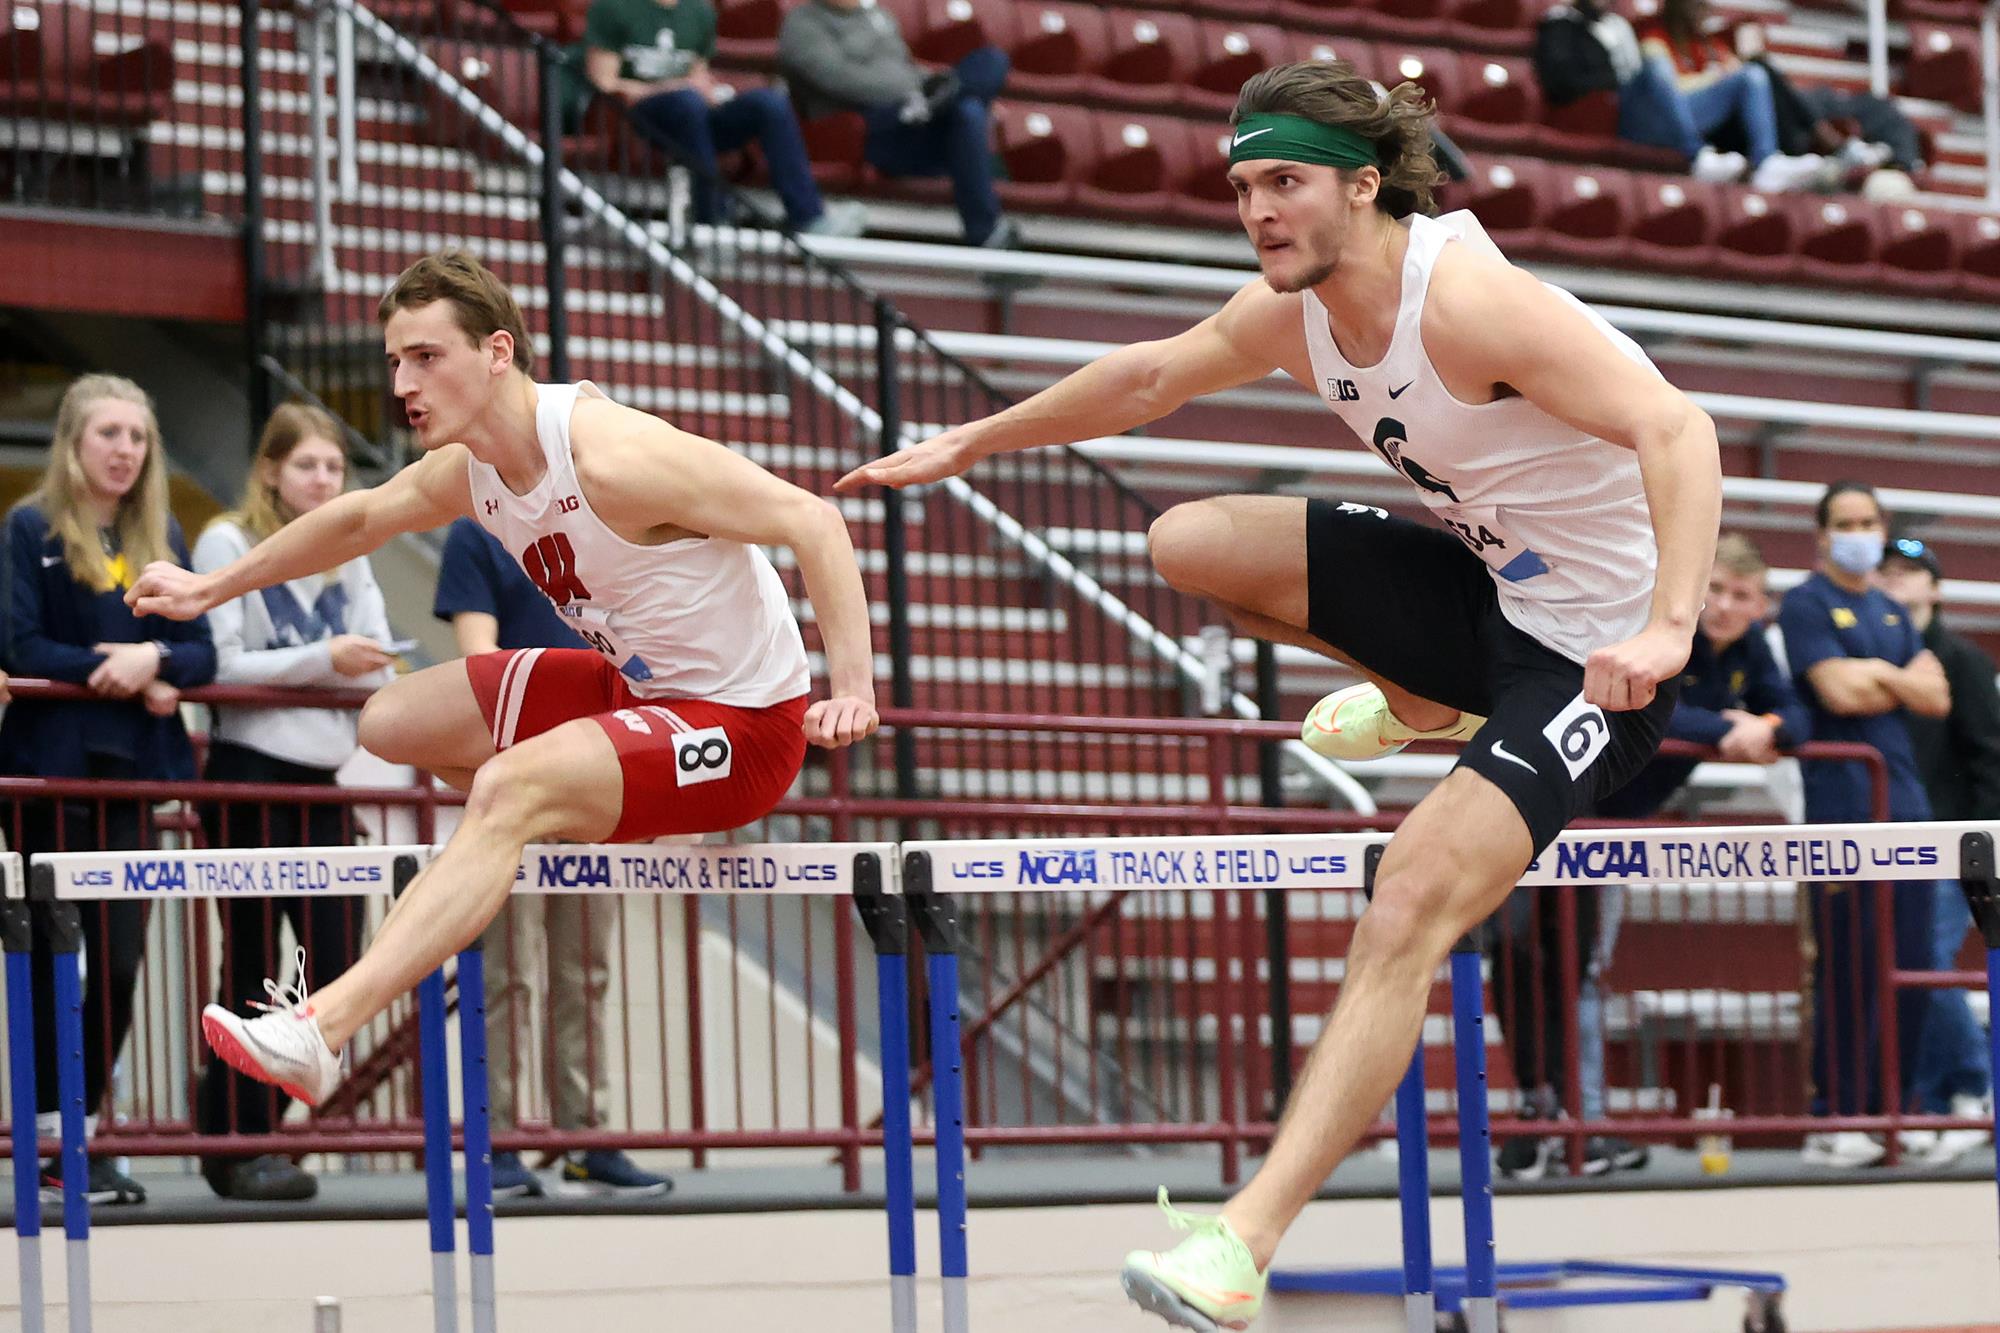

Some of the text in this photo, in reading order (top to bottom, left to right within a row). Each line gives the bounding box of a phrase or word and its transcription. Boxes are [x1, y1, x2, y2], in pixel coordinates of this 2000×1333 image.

[1560, 712, 1604, 762] 6
[678, 738, 729, 772] 8
[72, 860, 382, 891] UCS NCAA TRACK & FIELD UCS
[538, 855, 611, 888] NCAA
[620, 857, 691, 888] TRACK
[698, 857, 712, 888] &
[718, 856, 777, 888] FIELD
[785, 864, 838, 881] UCS
[951, 849, 1347, 885] UCS NCAA TRACK & FIELD UCS
[1555, 839, 1938, 879] NCAA TRACK & FIELD UCS
